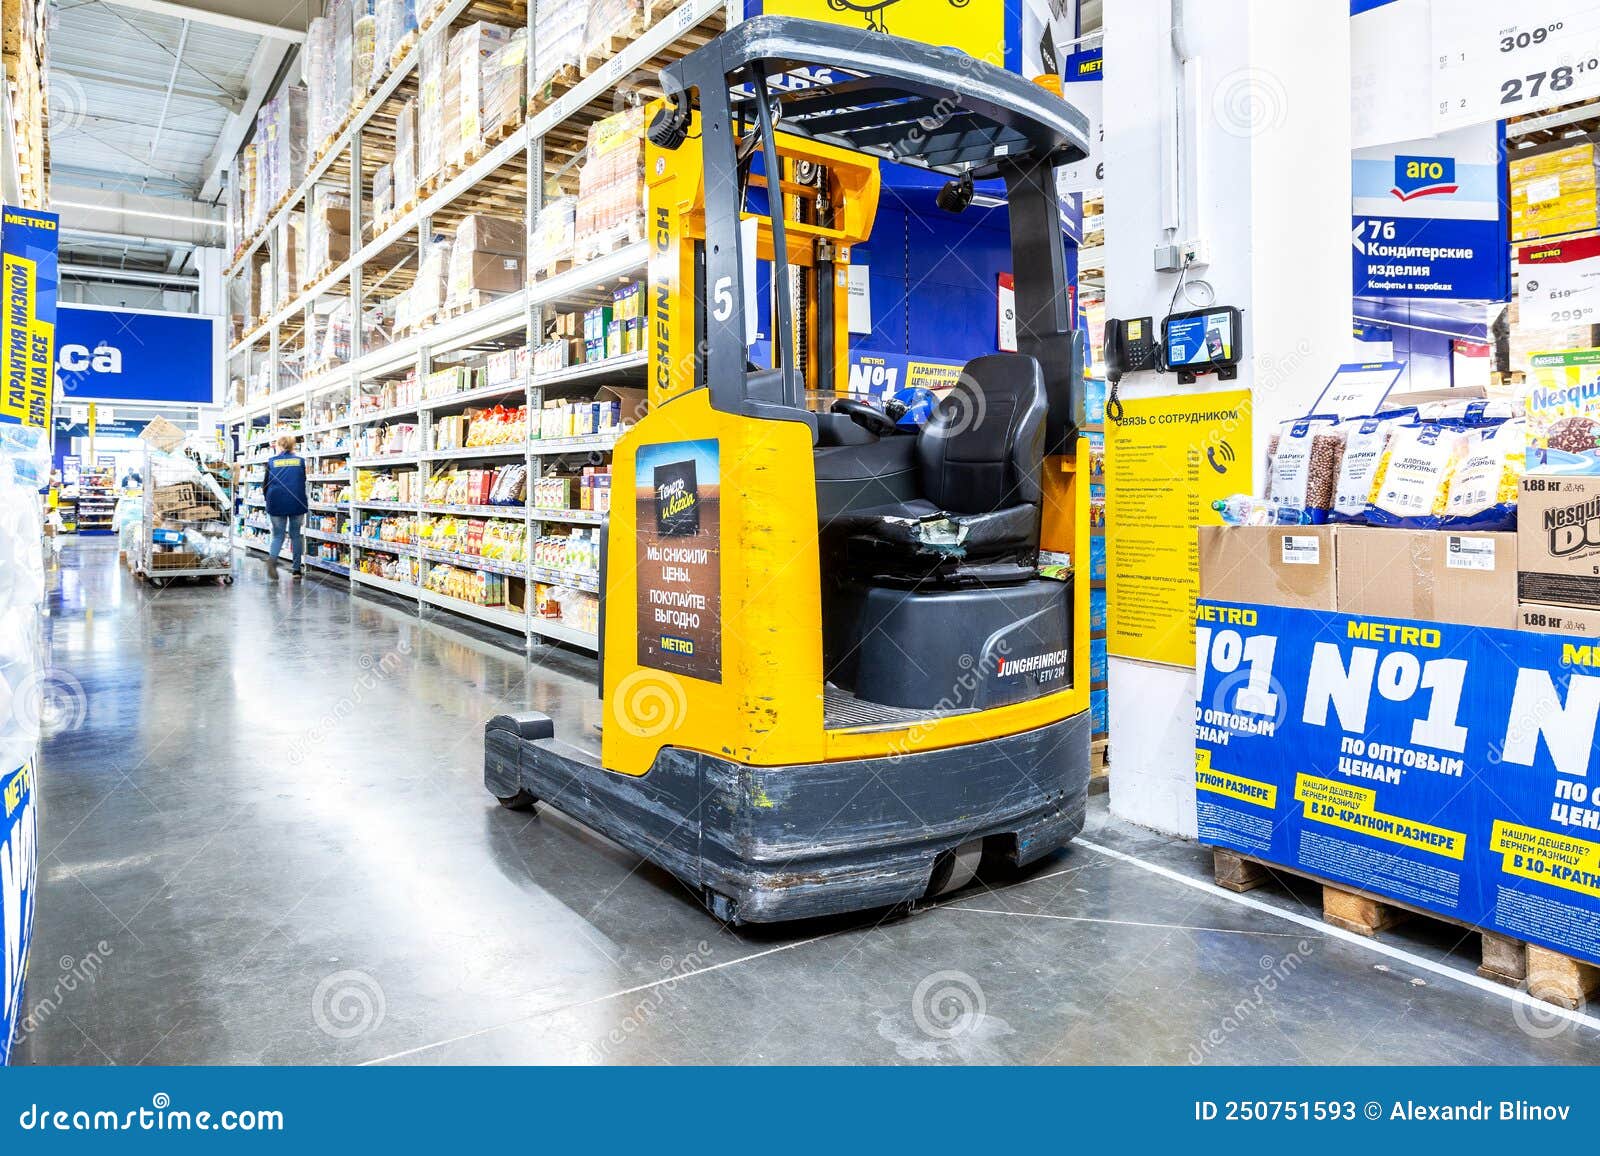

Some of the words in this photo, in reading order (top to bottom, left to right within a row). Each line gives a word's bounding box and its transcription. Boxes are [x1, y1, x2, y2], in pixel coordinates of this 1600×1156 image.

[1406, 161, 1443, 179] aro
[4, 213, 56, 231] METRO
[1367, 243, 1473, 260] Кондитерские
[1530, 249, 1560, 260] METRO
[1367, 264, 1430, 278] изделия
[5, 263, 29, 327] НИЗКОЙ
[1367, 281, 1406, 292] Конфеты
[1415, 282, 1452, 292] коробках
[712, 276, 733, 322] 5
[9, 328, 28, 410] ГАРАНТИЯ
[30, 368, 47, 390] НА
[1533, 375, 1600, 410] Nesqui
[28, 390, 47, 428] ЕНЫ
[1159, 410, 1238, 424] СОТРУДНИКОМ
[1347, 452, 1376, 460] ШАРИКИ
[1544, 496, 1600, 530] Nesqui
[1551, 518, 1600, 555] DU
[647, 547, 662, 561] МЫ
[663, 547, 708, 565] СНИЗИЛИ
[655, 608, 700, 629] ВЫГОДНО
[1347, 620, 1441, 649] METRO
[661, 637, 693, 655] METRO
[997, 650, 1068, 678] JUNGHEINRICH
[1039, 669, 1054, 683] ETV
[1204, 708, 1275, 737] ОПТОВЫМ
[1340, 736, 1366, 755] ПО
[1367, 742, 1464, 777] ОПТОВЫМ
[1225, 779, 1269, 801] РАЗМЕРЕ
[1301, 789, 1327, 800] ВЕРНЕМ
[1328, 796, 1361, 810] РАЗНИЦУ
[1302, 779, 1328, 792] НАШЛИ
[1329, 786, 1368, 802] ДЕШЕВЛЕ?
[1554, 779, 1588, 803] ПО
[1311, 801, 1319, 814] В
[1320, 804, 1394, 834] 10-КРАТНОМ
[1396, 824, 1455, 851] РАЗМЕРЕ
[1500, 839, 1535, 855] ВЕРНЕМ
[1537, 848, 1580, 867] РАЗНИЦУ
[1501, 827, 1536, 845] НАШЛИ
[1537, 834, 1590, 857] ДЕШЕВЛЕ?
[1513, 855, 1523, 869] В
